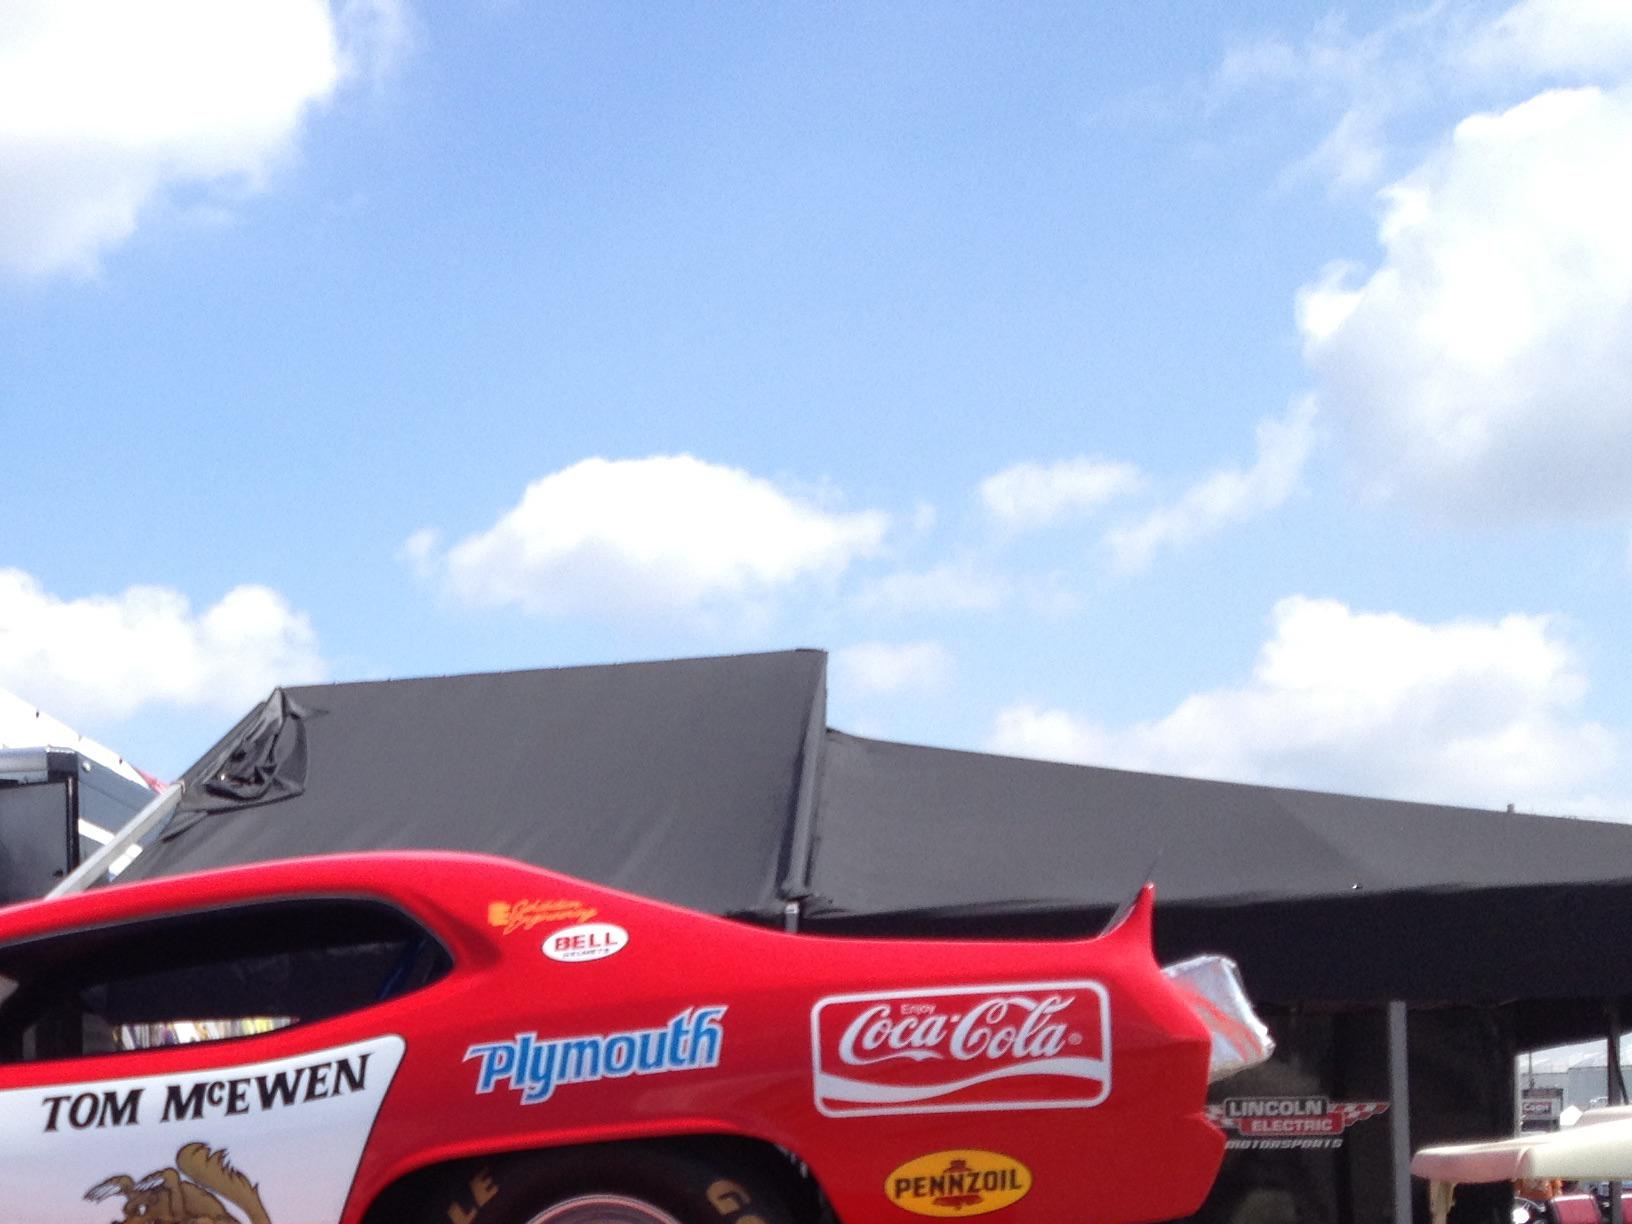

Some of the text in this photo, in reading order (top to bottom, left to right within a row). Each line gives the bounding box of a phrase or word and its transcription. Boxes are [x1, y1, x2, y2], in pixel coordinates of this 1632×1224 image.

[555, 932, 618, 951] BELL
[900, 1003, 936, 1016] Enjoy
[838, 994, 1076, 1065] Coca-Cola
[463, 1004, 728, 1105] Plymouth
[42, 1087, 144, 1132] TOM
[1229, 1100, 1323, 1116] LINCOLN
[1251, 1118, 1333, 1132] ELECTRIC
[894, 1168, 1023, 1200] PENNZOIL
